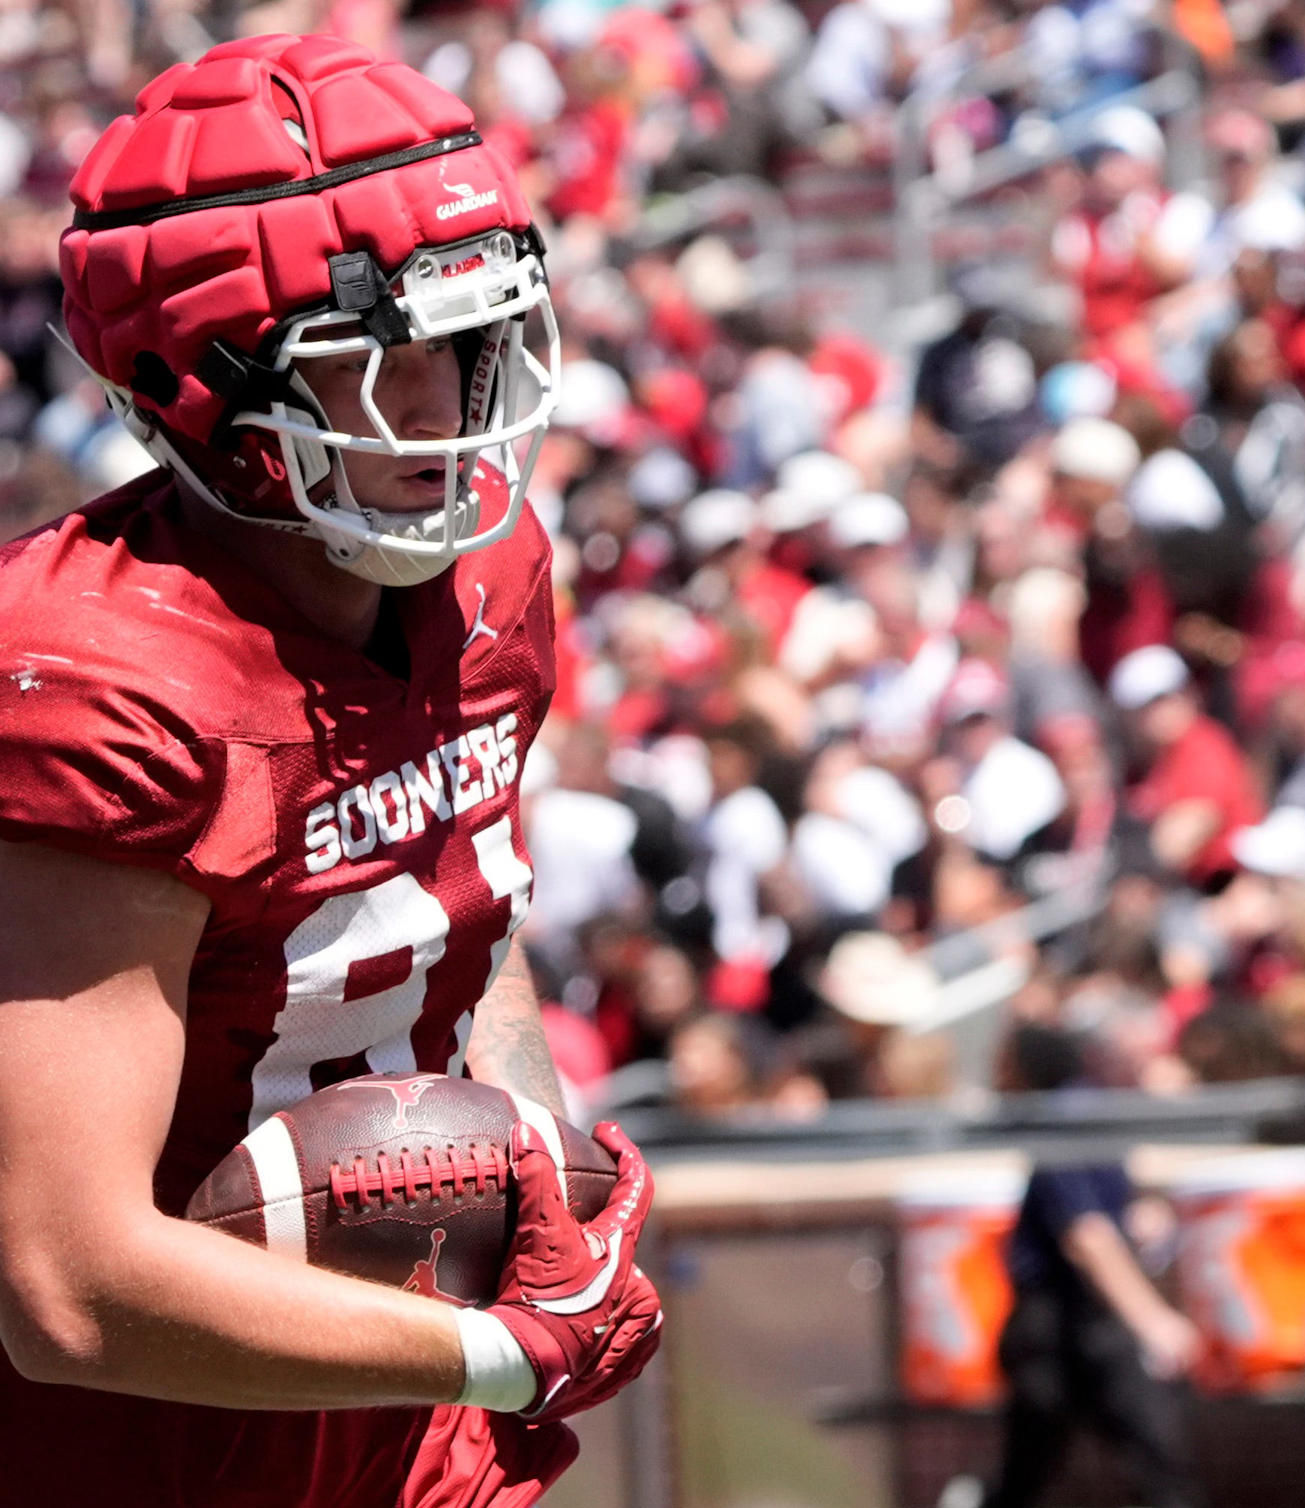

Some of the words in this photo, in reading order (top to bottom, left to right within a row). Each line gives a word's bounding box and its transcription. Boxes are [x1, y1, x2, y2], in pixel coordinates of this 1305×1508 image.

[436, 189, 498, 220] GUARDIAN
[470, 340, 497, 408] SPORT
[304, 712, 519, 875] SOONERS
